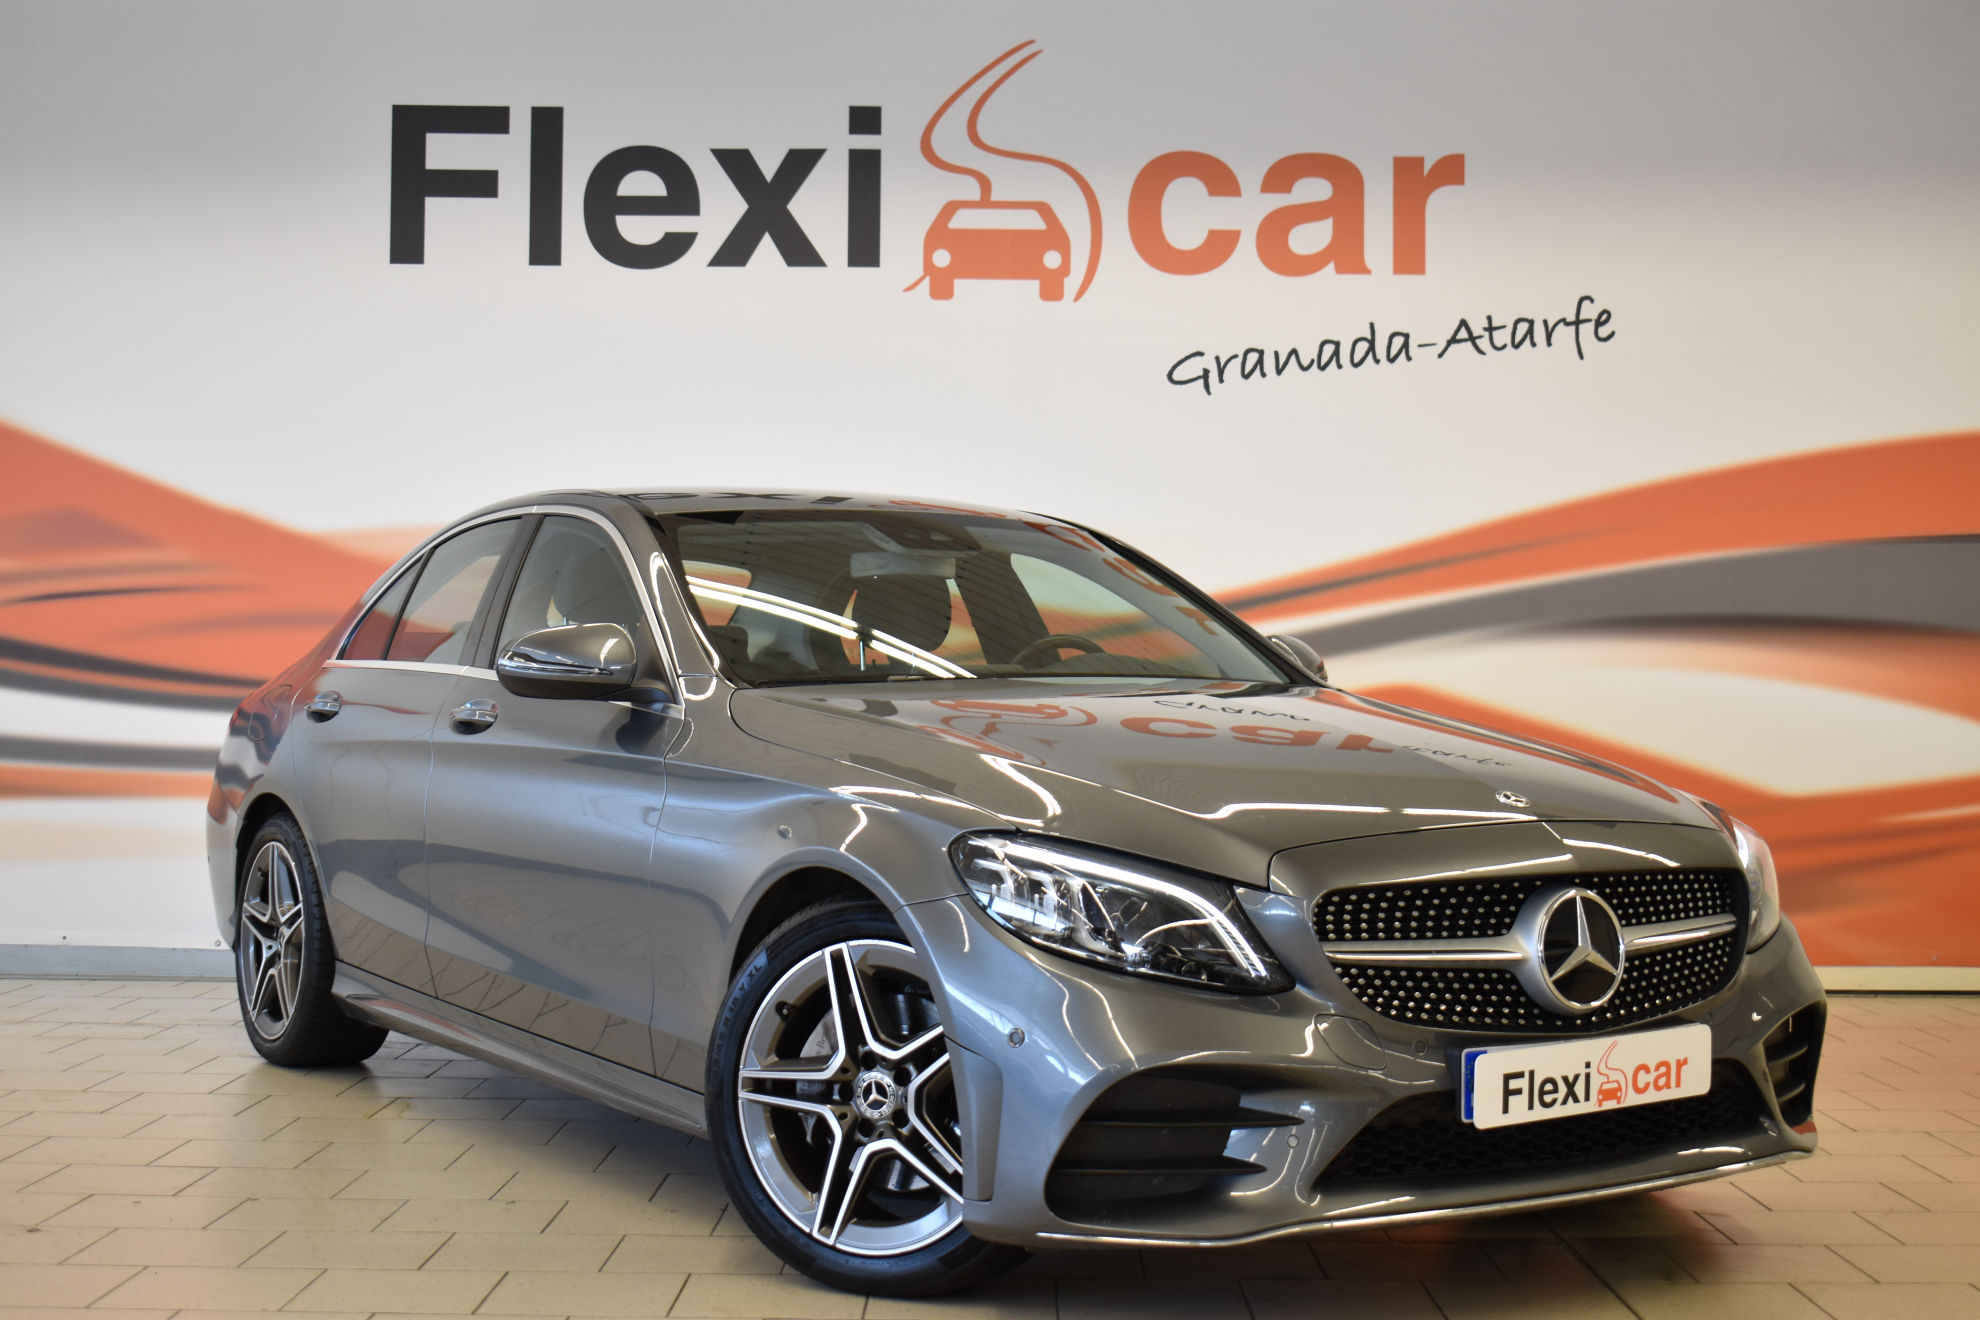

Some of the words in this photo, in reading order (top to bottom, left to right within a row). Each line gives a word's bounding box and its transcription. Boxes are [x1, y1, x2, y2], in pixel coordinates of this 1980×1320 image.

[389, 104, 882, 269] Flexi
[1128, 150, 1465, 277] car
[1166, 295, 1616, 396] Granada-Atarfe
[1501, 1061, 1591, 1115] Flexi
[1631, 1057, 1689, 1095] car
